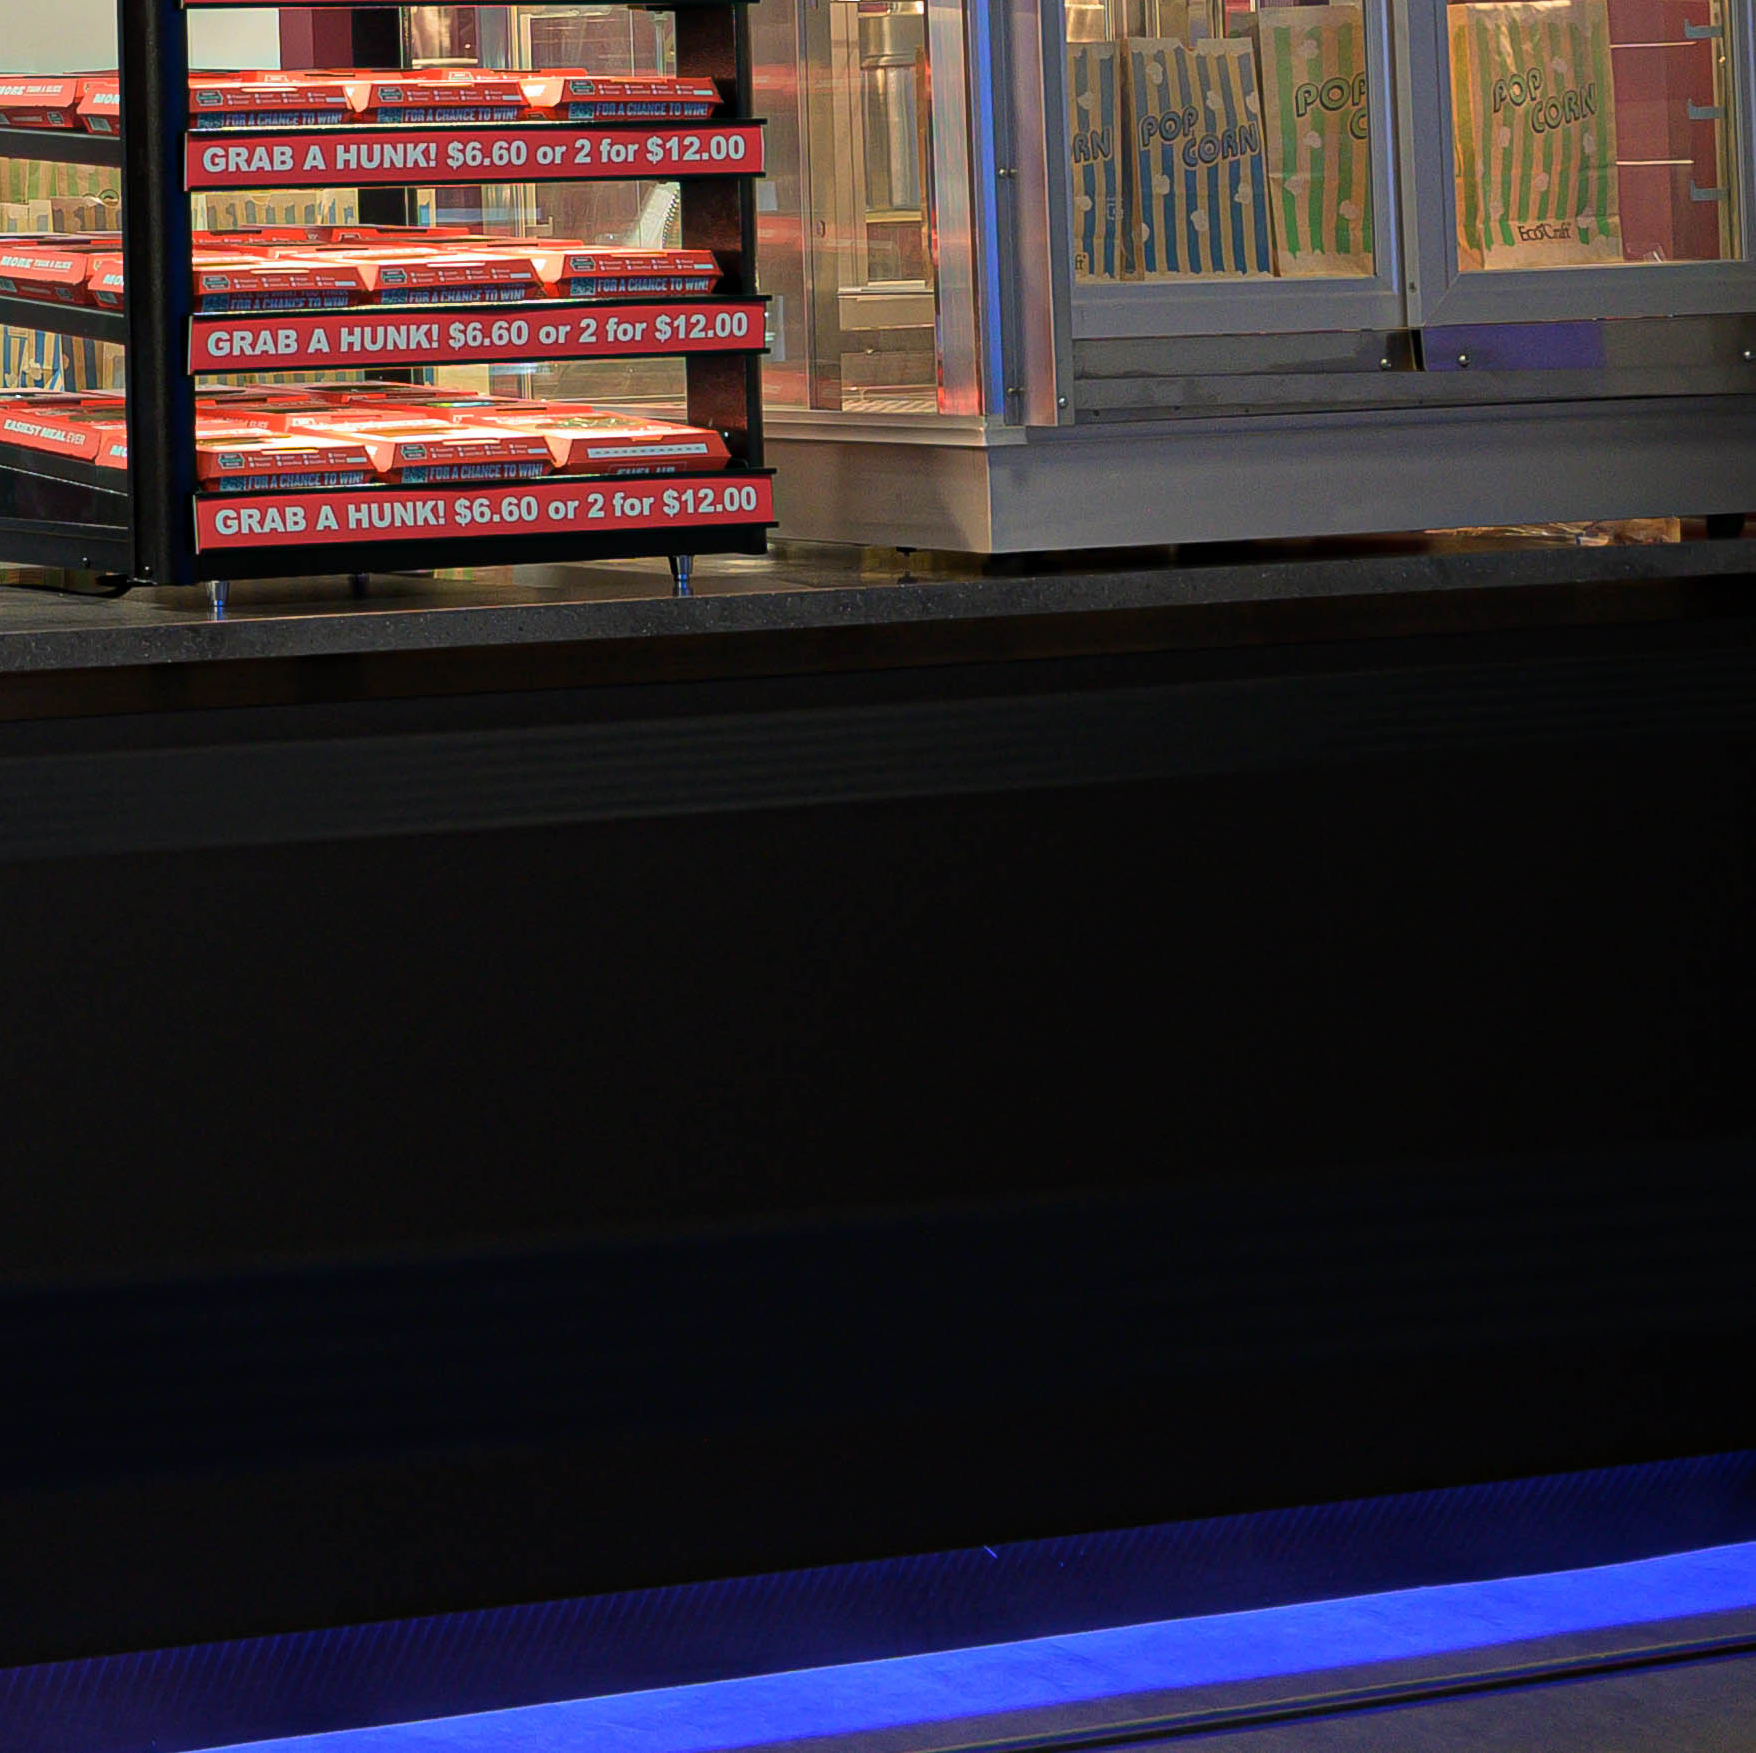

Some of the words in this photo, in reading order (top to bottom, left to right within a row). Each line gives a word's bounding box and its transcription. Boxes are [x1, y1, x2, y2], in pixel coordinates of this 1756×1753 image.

[1493, 67, 1542, 114] POP
[1531, 83, 1596, 134] CORN
[1141, 106, 1199, 148] POP
[1182, 120, 1259, 168] CORN
[203, 146, 293, 172] GRAB
[303, 145, 326, 170] A
[336, 143, 437, 169] HUNK!
[447, 141, 527, 169] $6.60
[537, 145, 567, 164] or
[574, 139, 591, 163] 2
[600, 138, 639, 163] for
[646, 135, 745, 164] $12.00
[0, 255, 33, 268] MORE
[598, 279, 618, 292] FOR
[619, 279, 626, 292] A
[628, 278, 667, 292] CHANCE
[669, 278, 683, 291] TO
[685, 277, 709, 291] WIN!
[207, 330, 298, 356] GRAB
[307, 328, 330, 353] A
[340, 324, 439, 351] HUNK!
[449, 320, 528, 350] $6.60
[539, 324, 571, 343] or
[579, 319, 597, 343] 2
[606, 318, 647, 342] for
[655, 312, 748, 342] $12.00
[66, 430, 86, 446] EVER
[215, 506, 306, 534] GRAB
[316, 505, 338, 530] A
[348, 501, 445, 529] HUNK!
[455, 496, 538, 526] $6.60
[548, 500, 579, 519] or
[587, 493, 605, 518] 2
[613, 492, 654, 516] for
[663, 486, 756, 517] $12.00
